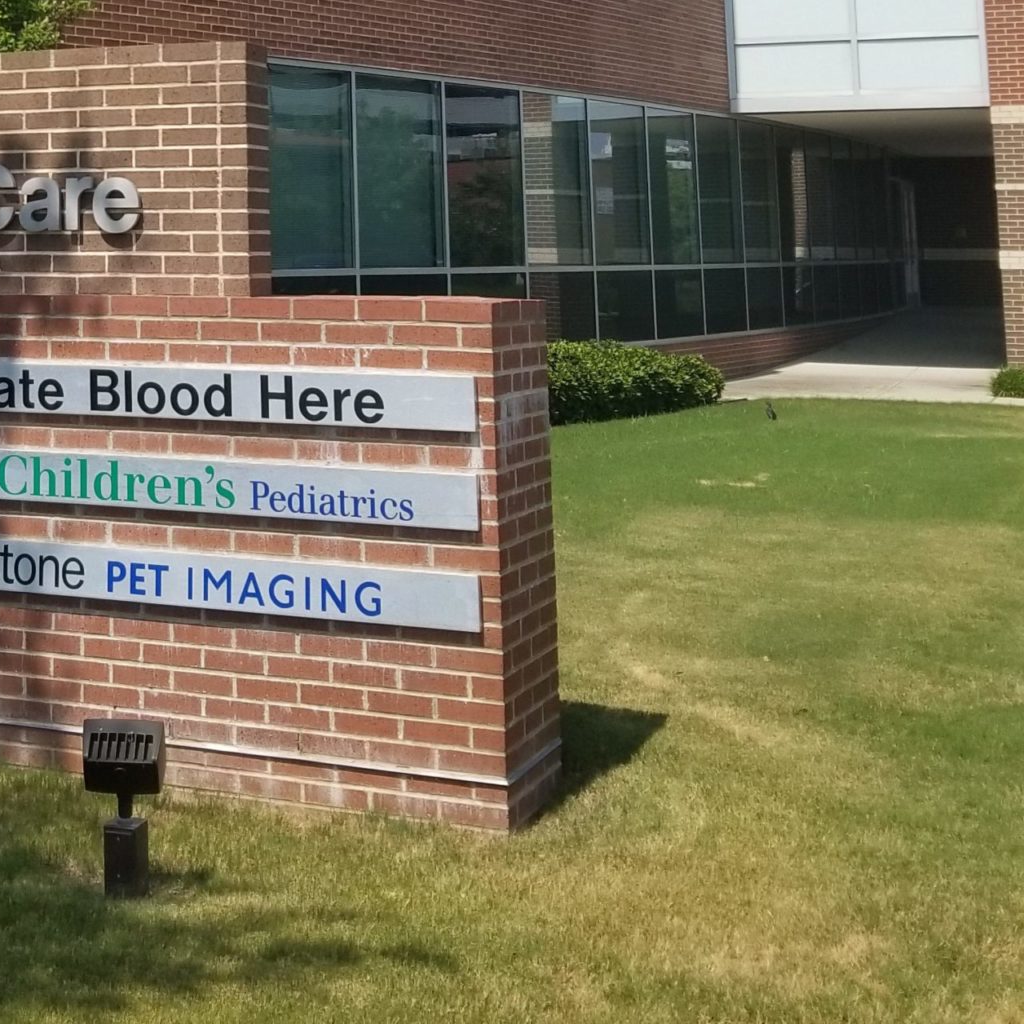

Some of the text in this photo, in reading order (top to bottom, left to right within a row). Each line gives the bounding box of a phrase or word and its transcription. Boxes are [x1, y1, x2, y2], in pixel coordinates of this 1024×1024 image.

[89, 369, 232, 417] Blood
[260, 375, 384, 424] Here
[249, 480, 414, 521] Pediatrics
[107, 560, 169, 596] PET
[186, 565, 382, 616] IMAGING
